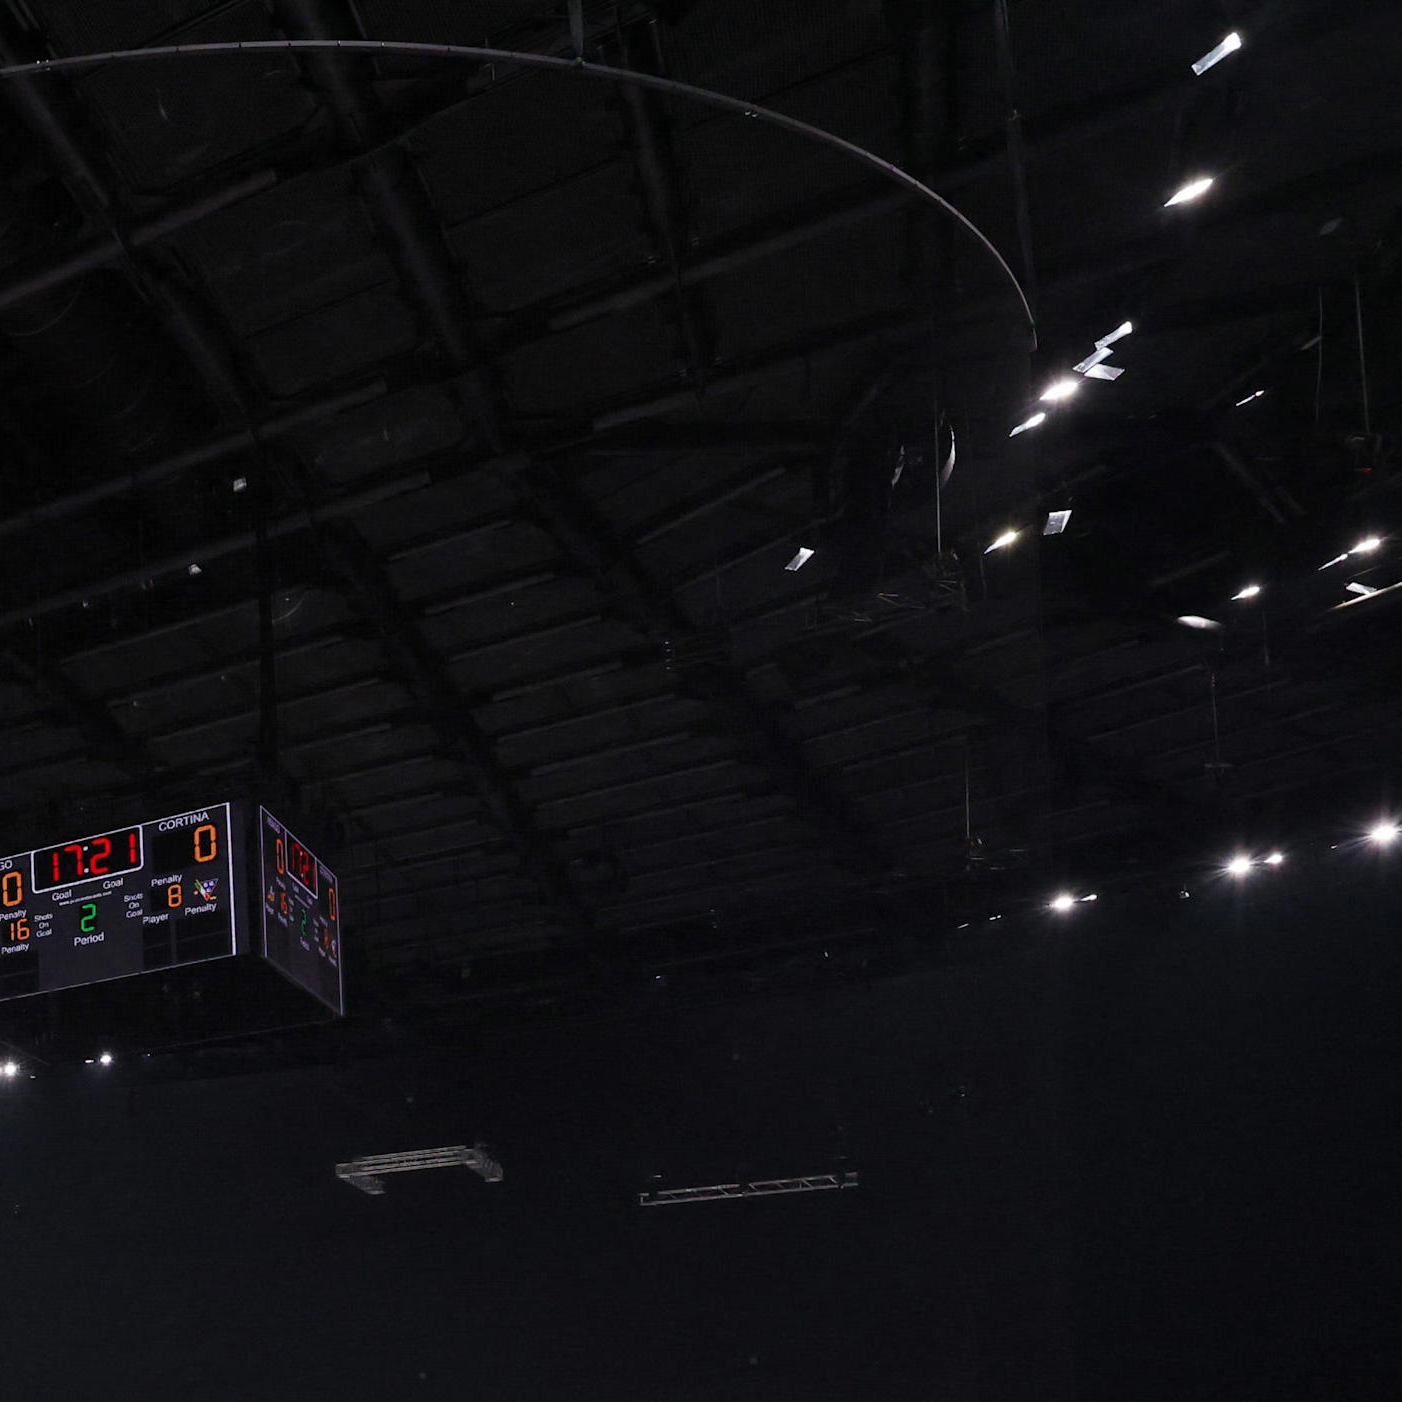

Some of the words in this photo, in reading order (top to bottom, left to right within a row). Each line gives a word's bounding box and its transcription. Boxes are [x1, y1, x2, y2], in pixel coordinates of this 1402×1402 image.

[158, 811, 210, 831] CORTINA
[193, 824, 217, 863] 0
[52, 833, 137, 882] 17:21
[103, 878, 124, 890] Goal
[151, 874, 183, 887] Penalty
[2, 871, 23, 907] 0
[52, 889, 72, 901] Goal
[123, 893, 143, 903] Shots
[167, 884, 183, 908] 8
[129, 902, 140, 910] On
[184, 902, 217, 916] Penalty
[34, 913, 53, 922] Shots
[80, 903, 96, 932] 2
[126, 909, 143, 919] Goal
[143, 913, 169, 924] Player
[10, 918, 30, 941] 16
[39, 921, 49, 929] On
[36, 928, 52, 938] Goal
[74, 932, 105, 946] Period
[1, 943, 29, 955] Penalty
